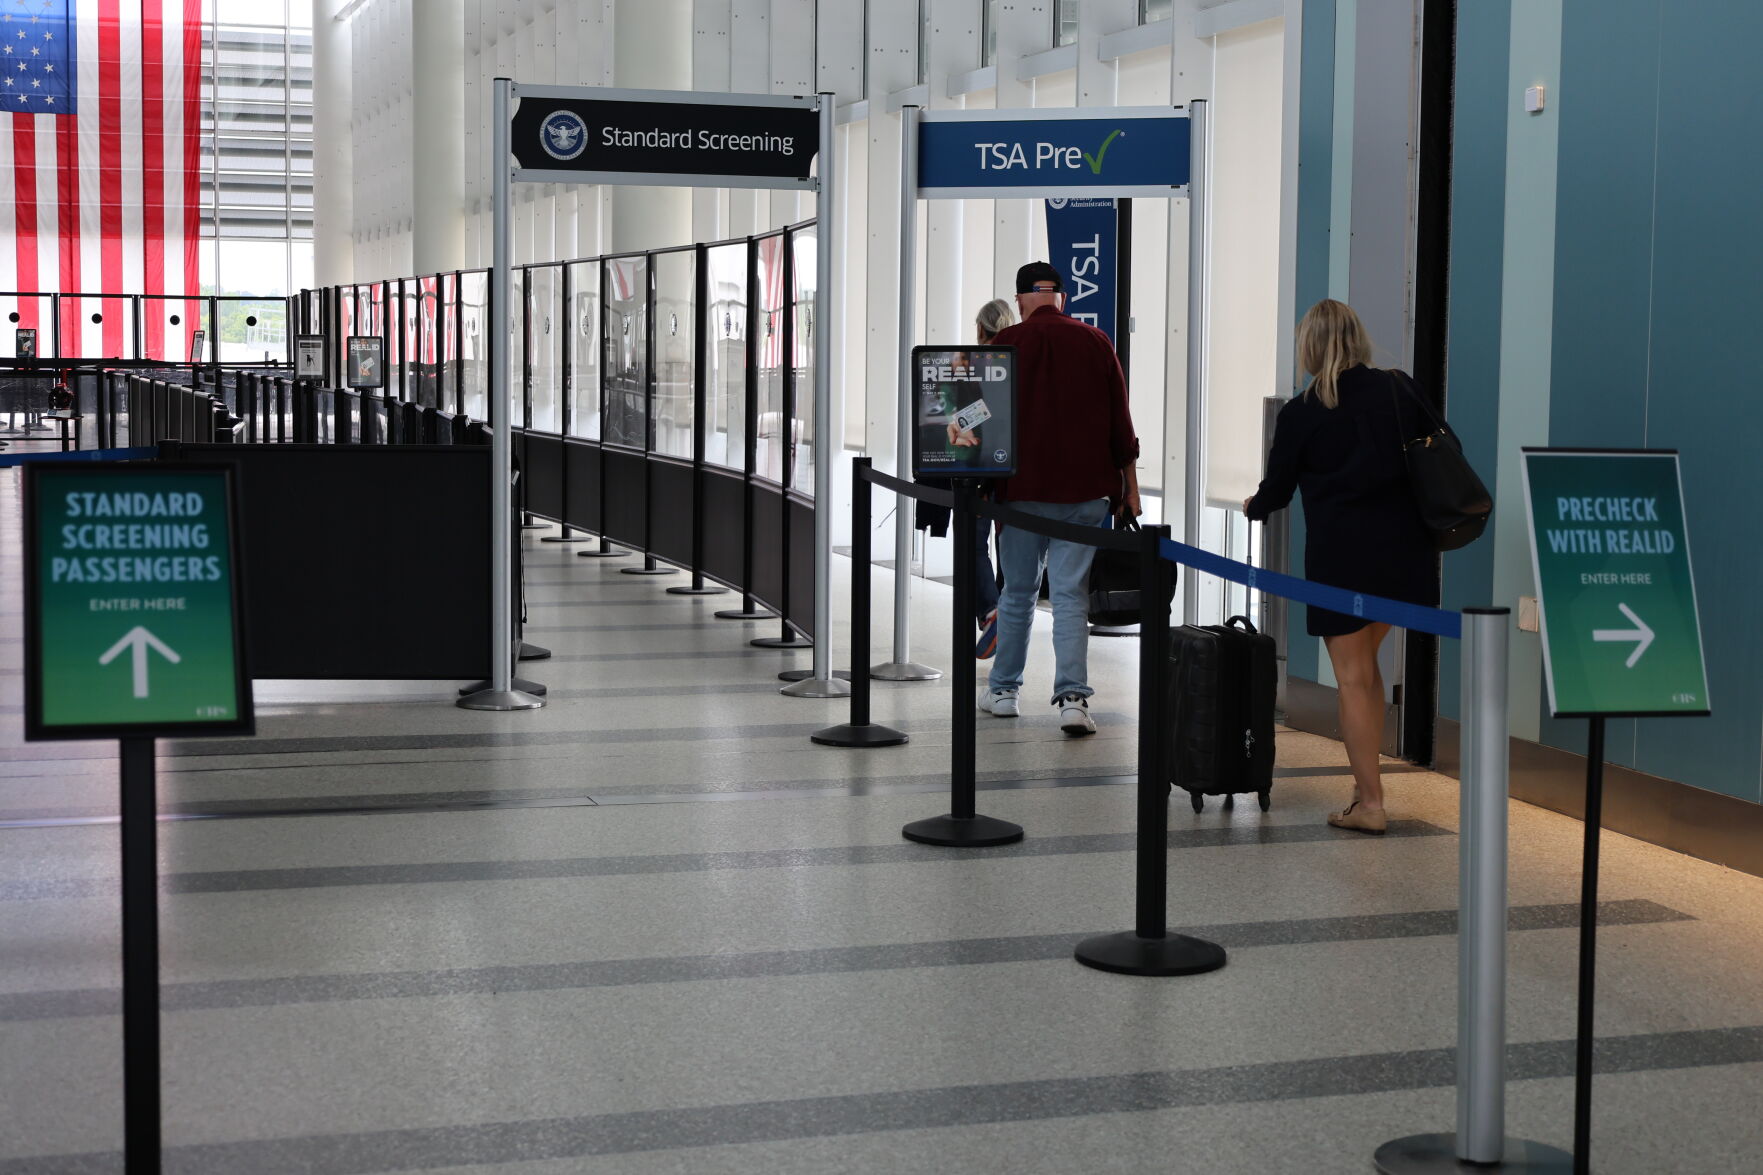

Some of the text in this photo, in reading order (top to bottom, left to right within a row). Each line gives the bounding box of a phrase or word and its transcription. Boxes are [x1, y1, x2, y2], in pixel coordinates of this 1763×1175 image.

[601, 126, 692, 149] Standard
[698, 130, 794, 156] Screening
[974, 142, 1082, 170] TSA Pre
[1070, 200, 1112, 208] Administration
[1071, 233, 1100, 303] TSA
[922, 366, 1007, 382] REAL ID
[65, 492, 203, 517] STANDARD
[1557, 497, 1659, 522] PRECHECK
[61, 523, 209, 549] SCREENING
[1547, 529, 1601, 554] WITH
[52, 556, 221, 583] PASSENGERS
[1581, 573, 1653, 584] ENTER HERE
[89, 597, 186, 611] ENTER HERE
